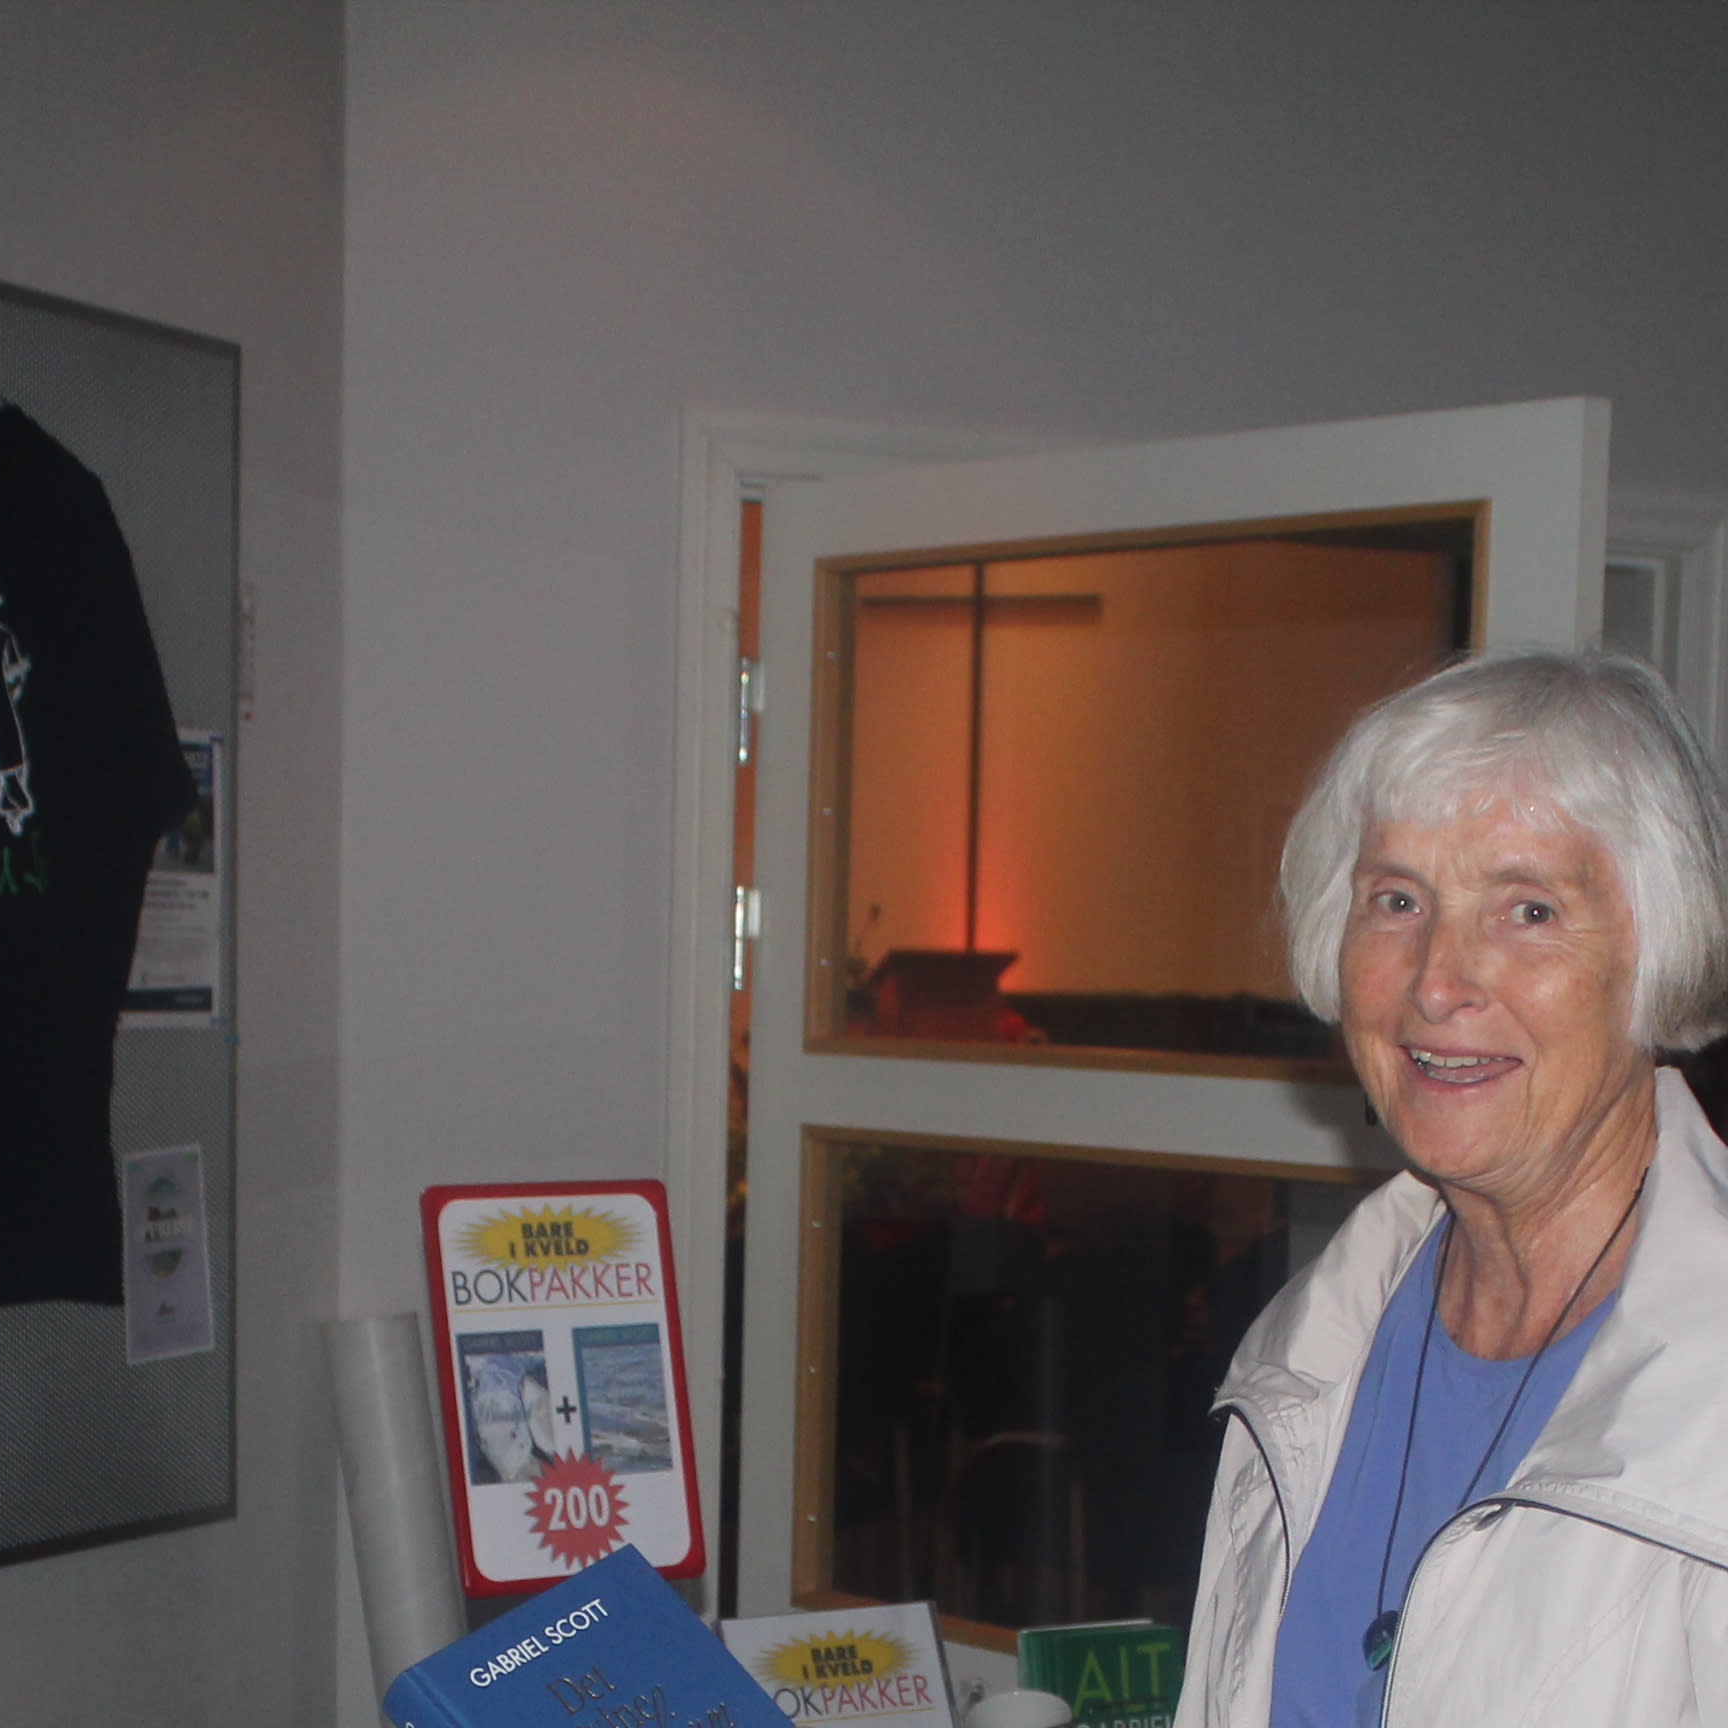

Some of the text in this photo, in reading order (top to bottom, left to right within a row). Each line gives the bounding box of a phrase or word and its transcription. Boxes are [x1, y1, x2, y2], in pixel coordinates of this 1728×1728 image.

[522, 1221, 575, 1239] BARE
[524, 1239, 590, 1257] KVELD
[450, 1263, 655, 1306] BOKPAKKER
[544, 1485, 610, 1531] 200
[469, 1598, 608, 1688] GABRIEL SCOTT
[810, 1644, 858, 1665] BARE
[814, 1658, 873, 1678] KVELD
[1072, 1642, 1170, 1719] ALT
[774, 1676, 932, 1718] OKPAKKER
